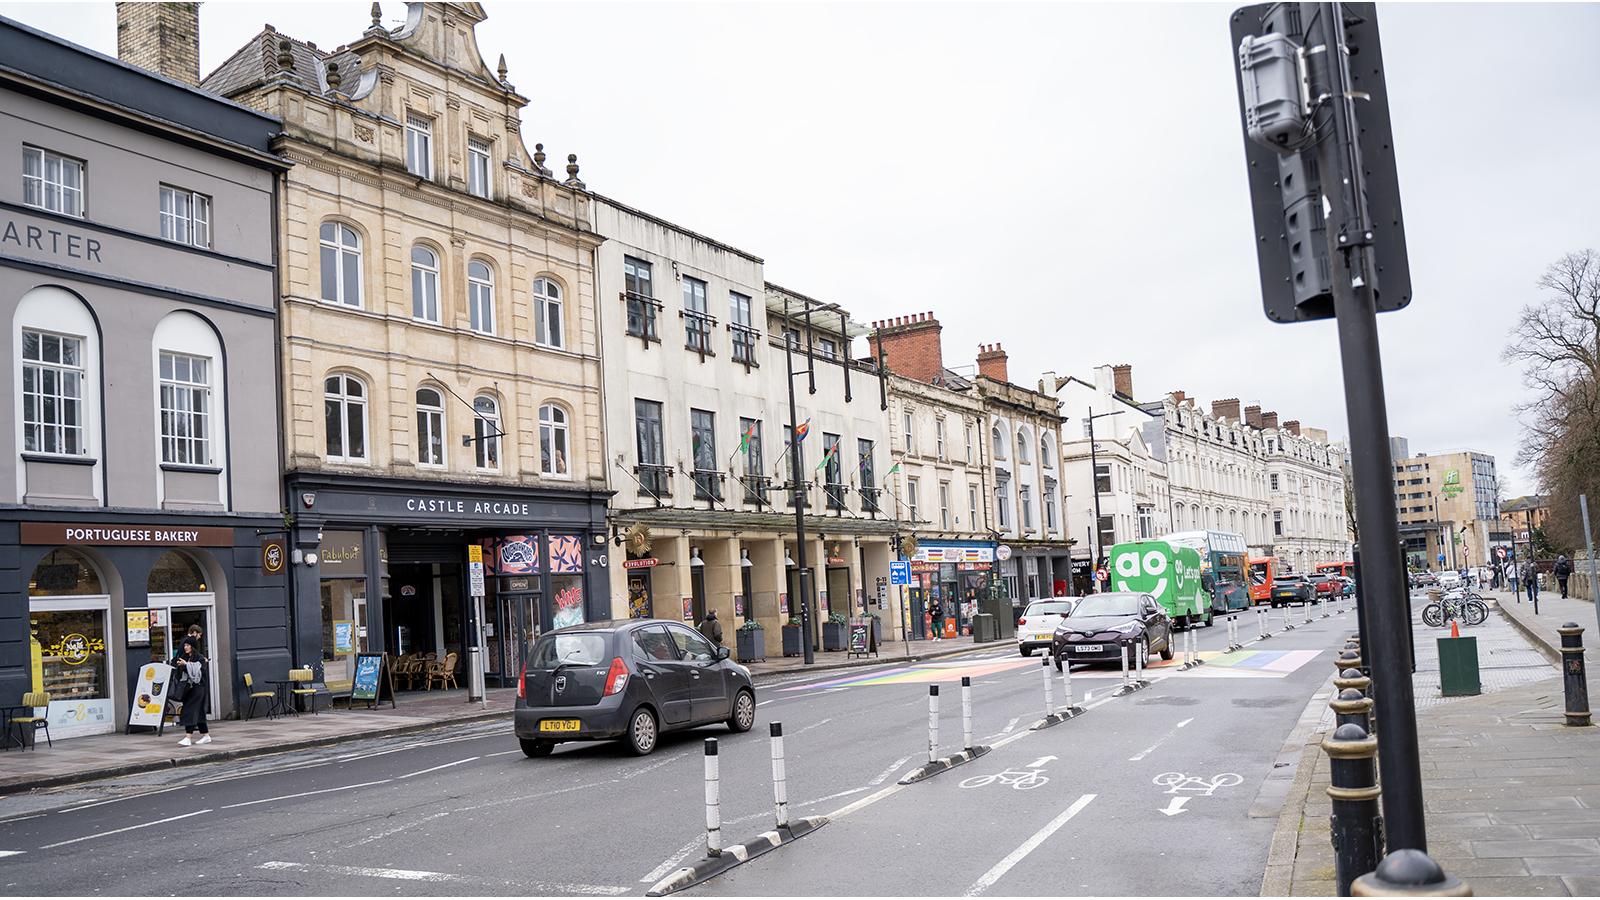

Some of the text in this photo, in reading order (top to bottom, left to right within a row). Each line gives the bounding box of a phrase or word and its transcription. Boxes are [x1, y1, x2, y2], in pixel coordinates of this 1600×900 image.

[2, 221, 102, 263] ARTER
[406, 499, 528, 515] CASTLE ARCADE
[66, 528, 198, 542] PORTUGUESE BAKERY
[1115, 550, 1167, 578] ao
